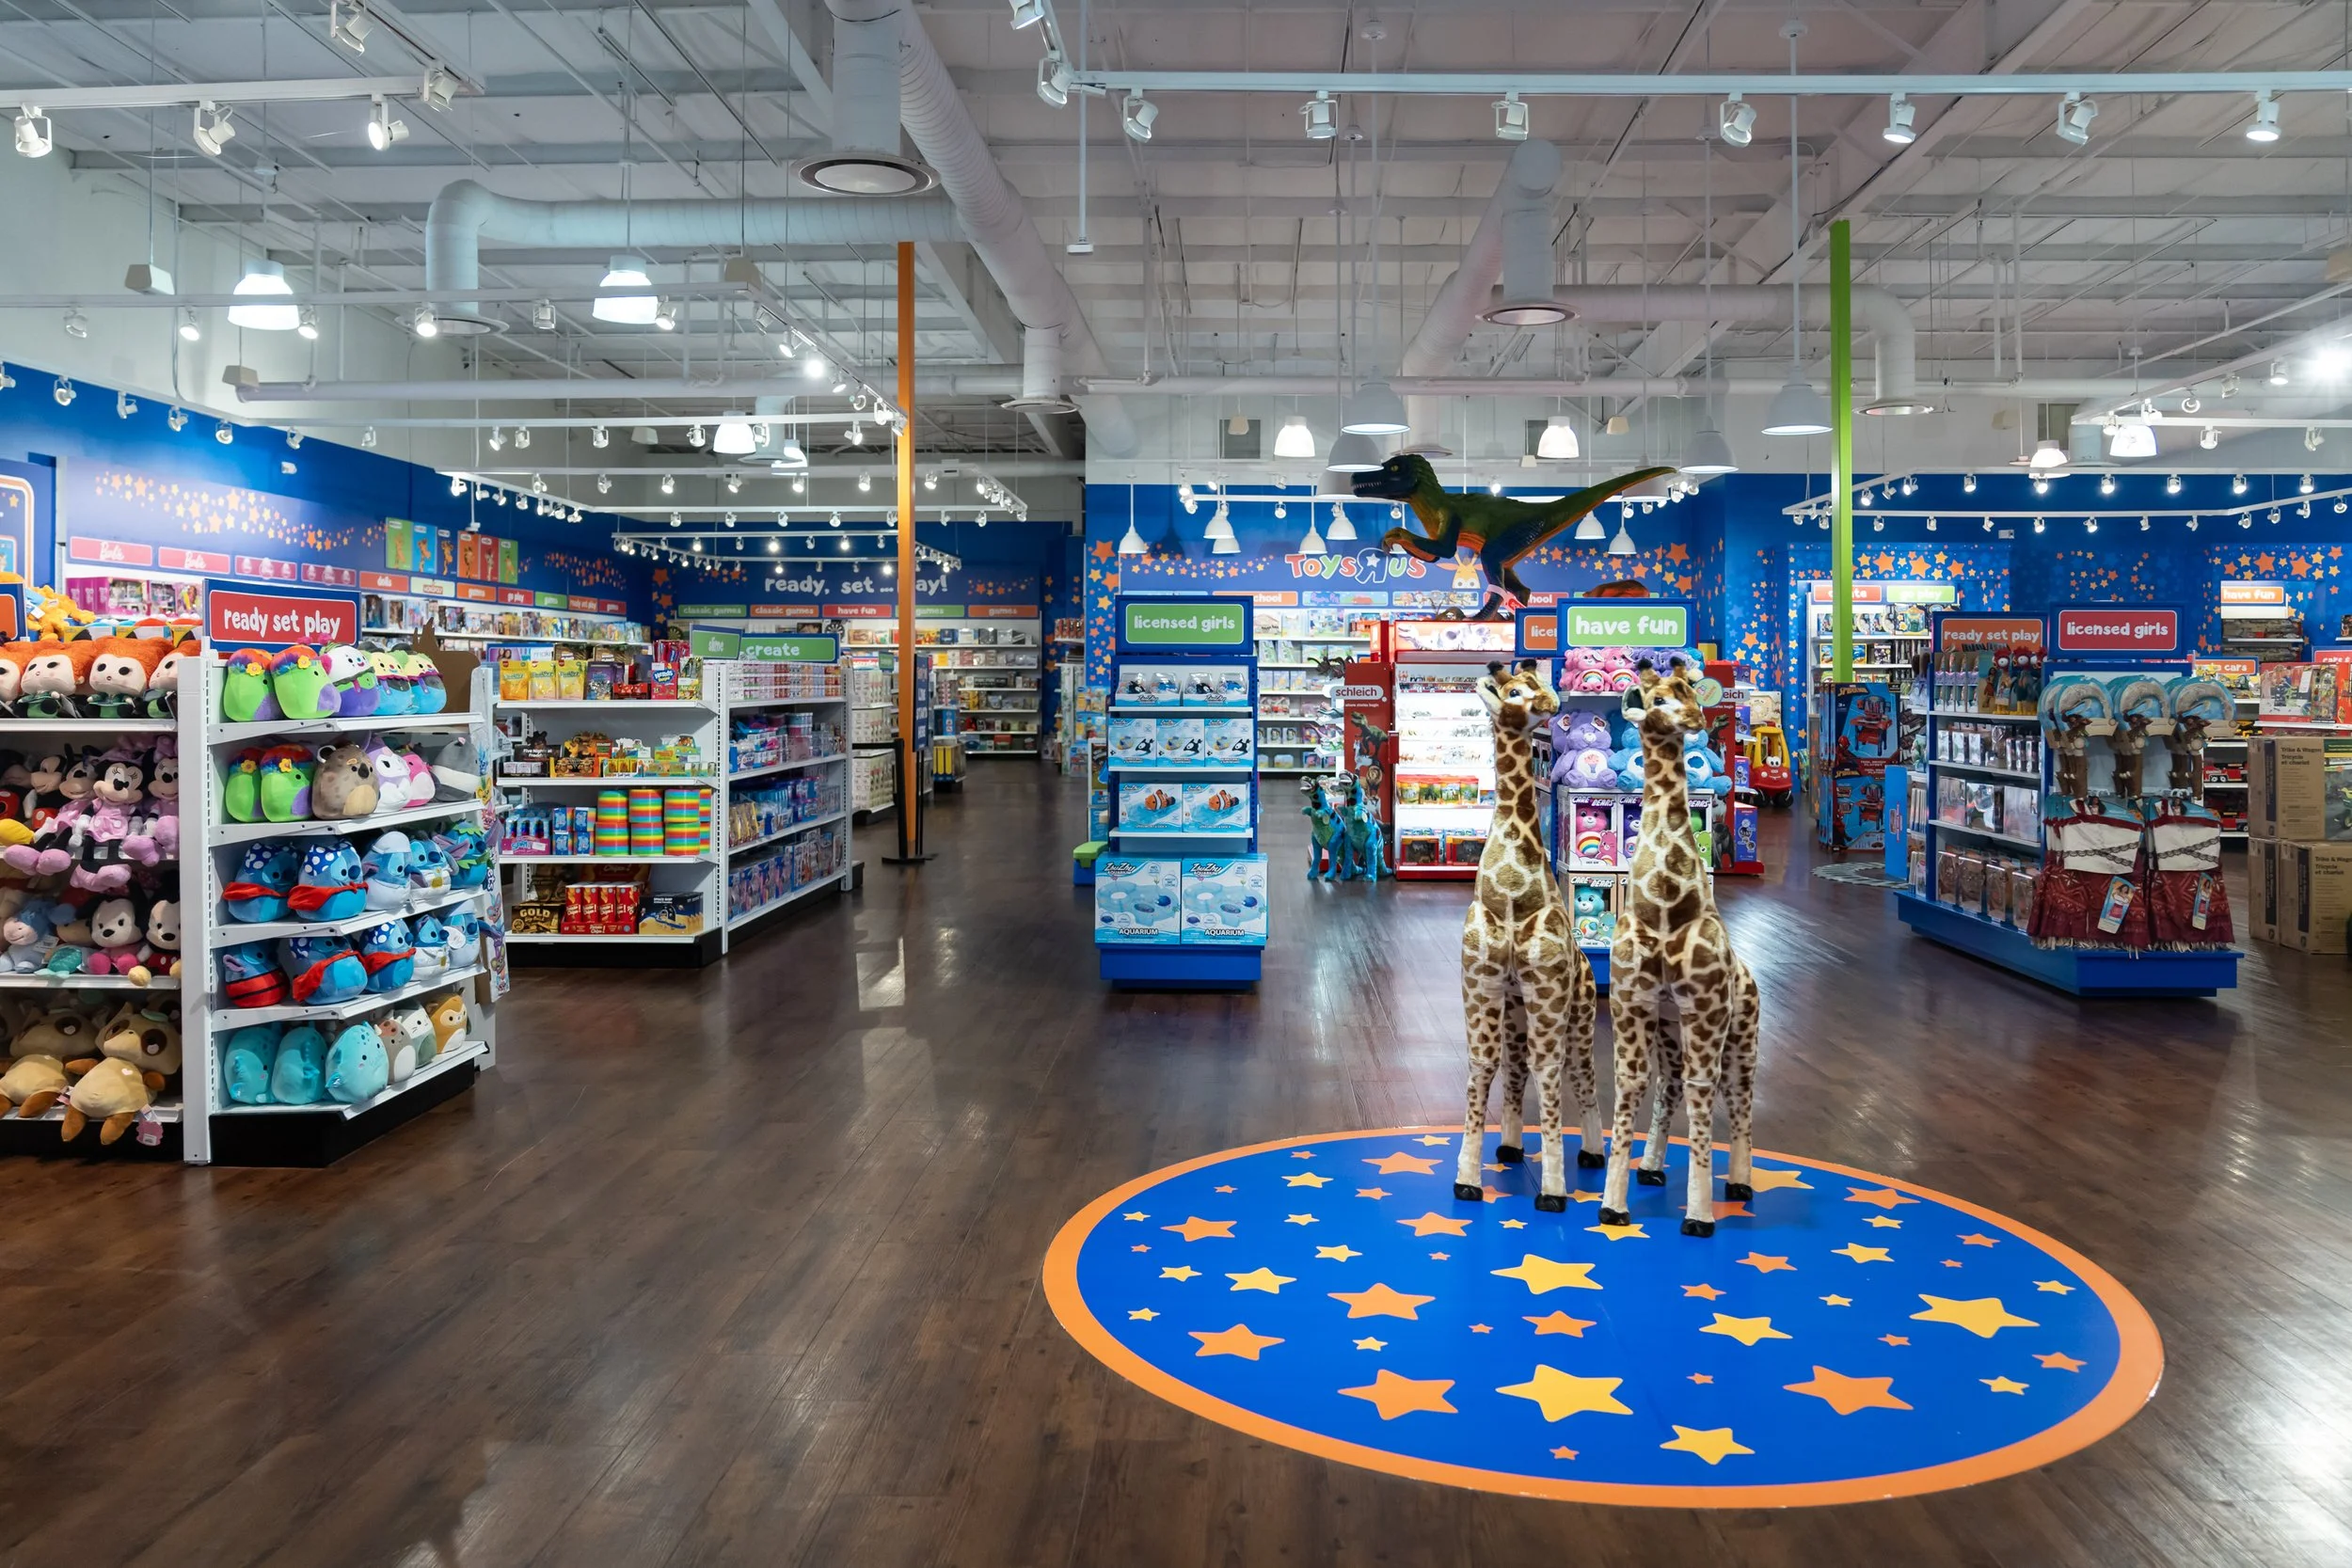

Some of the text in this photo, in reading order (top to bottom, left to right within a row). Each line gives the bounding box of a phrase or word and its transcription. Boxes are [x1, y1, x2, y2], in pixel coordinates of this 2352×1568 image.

[765, 575, 830, 596] ready,
[840, 576, 874, 594] set
[2223, 590, 2275, 600] have fun
[683, 606, 741, 616] classic games
[755, 606, 814, 616] classic games
[837, 607, 877, 615] have fun
[915, 608, 945, 616] games
[989, 608, 1018, 616] games
[224, 607, 341, 640] ready set play
[1134, 615, 1235, 632] licensed girls
[1575, 615, 1678, 635] have fun
[1531, 625, 1557, 637] lice
[2067, 622, 2169, 639] licensed girls
[1944, 629, 2040, 643] ready set play
[746, 642, 800, 657] create
[2224, 662, 2248, 672] cars
[1336, 687, 1377, 696] schleich
[1723, 689, 1744, 699] eich
[1591, 799, 1614, 807] BEARS
[1570, 876, 1614, 887] CARE BEARS
[519, 908, 550, 918] GOLD
